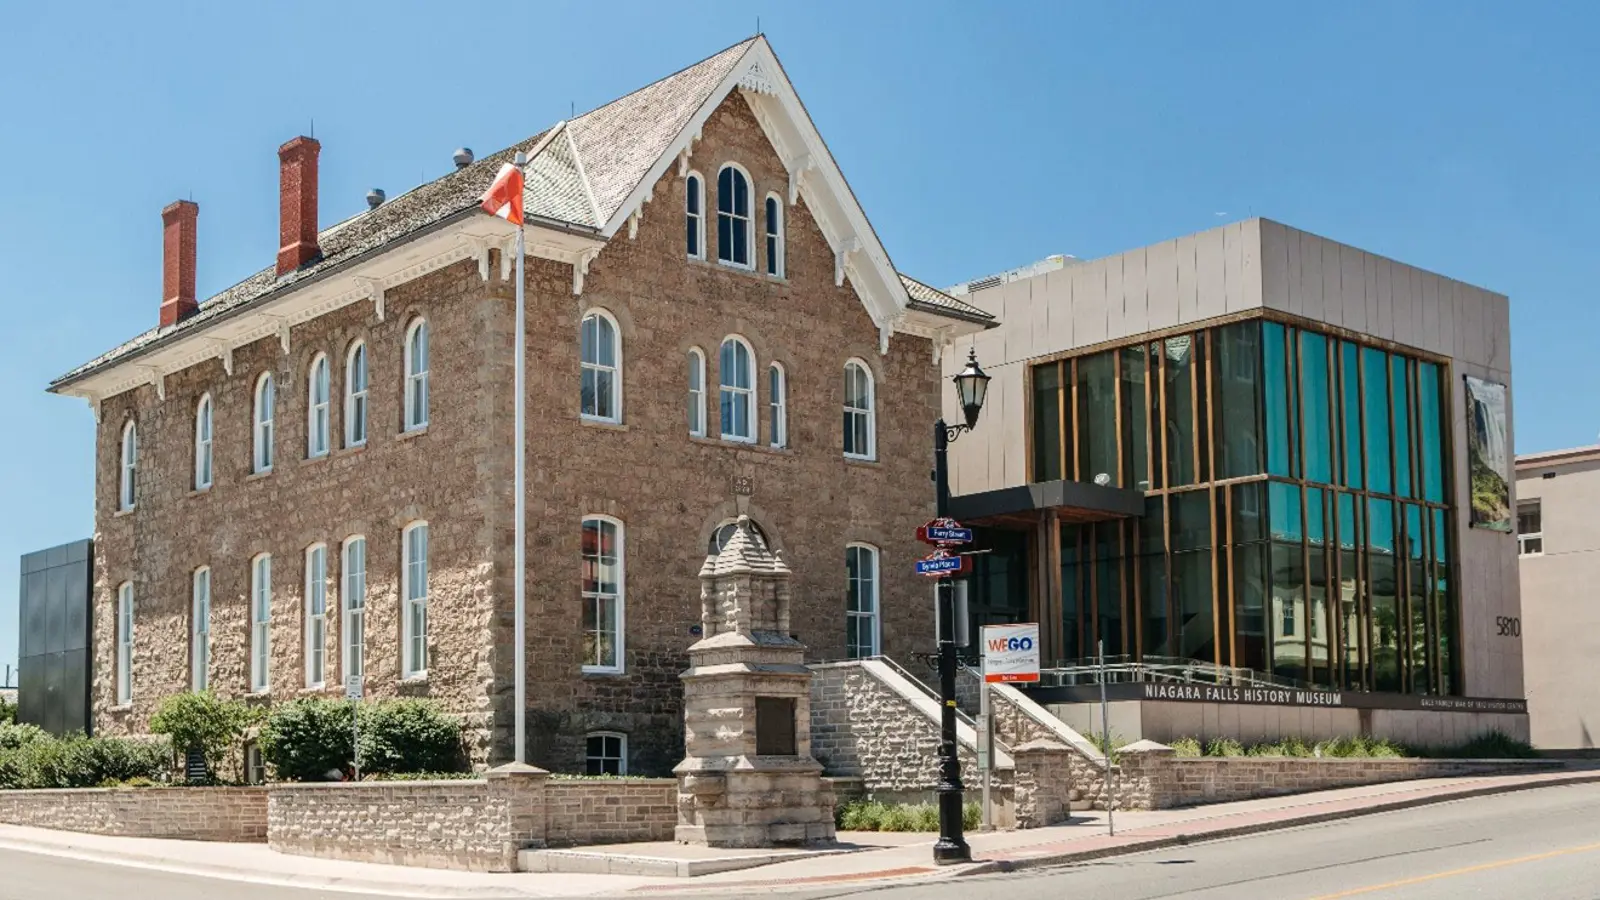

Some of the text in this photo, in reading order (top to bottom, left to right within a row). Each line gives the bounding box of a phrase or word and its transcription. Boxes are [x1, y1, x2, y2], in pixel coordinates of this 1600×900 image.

[1496, 616, 1520, 637] 5810
[988, 637, 1033, 651] WEGO
[1145, 684, 1342, 705] NIAGARA FALLS HISTORY MUSEUM
